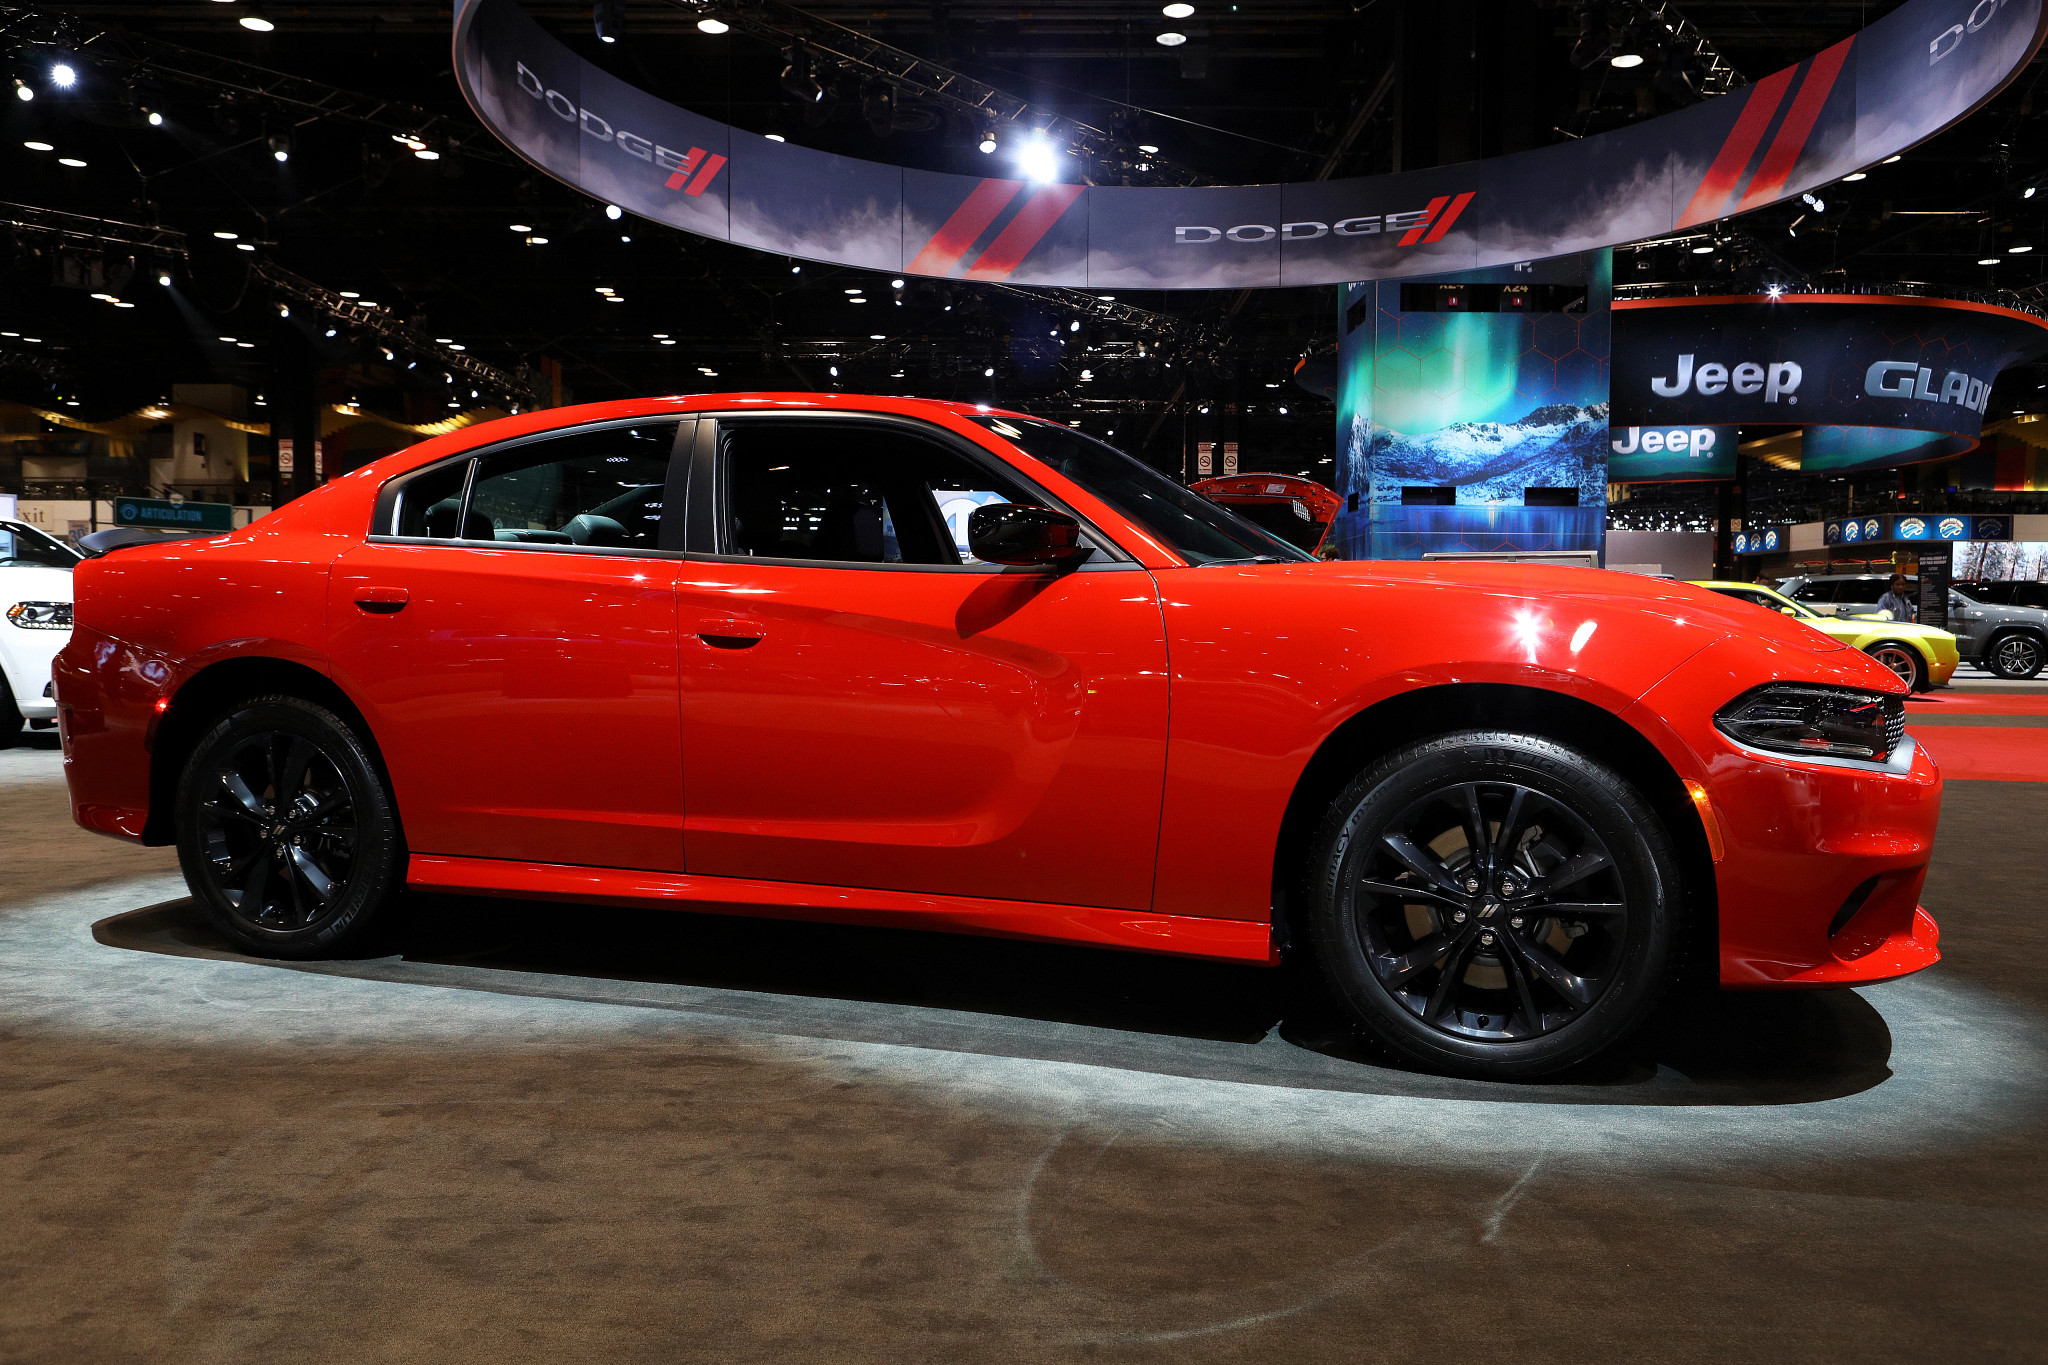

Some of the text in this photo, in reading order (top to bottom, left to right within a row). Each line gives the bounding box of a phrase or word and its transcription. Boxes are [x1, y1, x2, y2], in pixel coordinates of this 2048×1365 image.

[1929, 0, 2008, 66] DO
[517, 60, 690, 177] DODGE
[1175, 210, 1429, 243] DODGE
[1651, 353, 1802, 403] Jeep
[1864, 361, 1991, 415] GLADI
[1612, 426, 1716, 457] Jeep
[17, 507, 45, 523] xit
[140, 507, 203, 523] ARTICULATION
